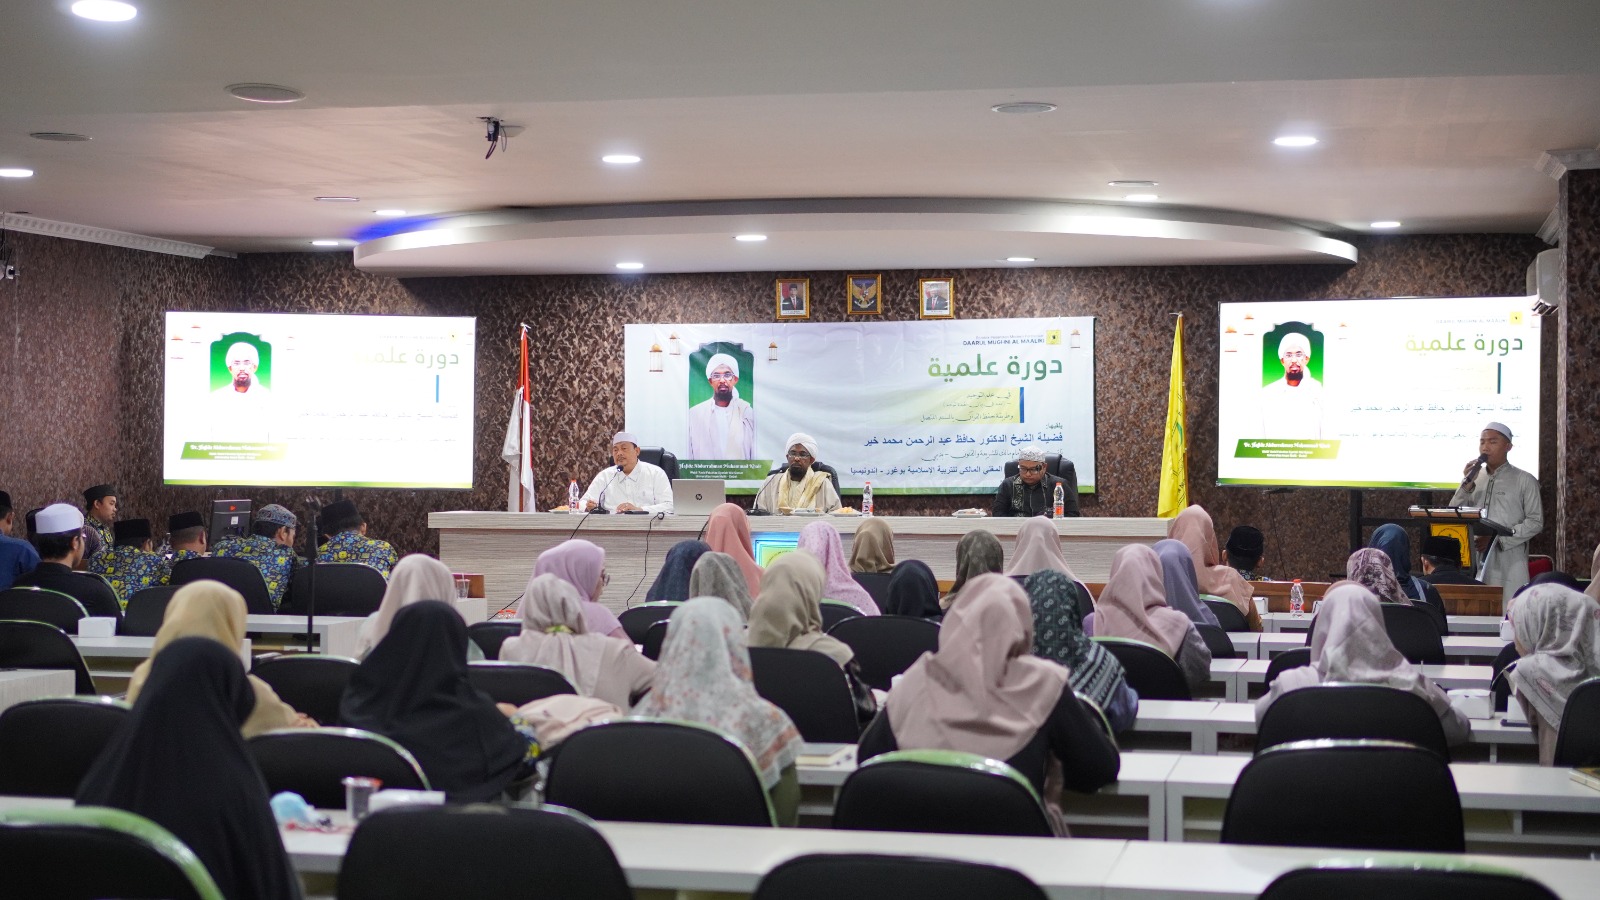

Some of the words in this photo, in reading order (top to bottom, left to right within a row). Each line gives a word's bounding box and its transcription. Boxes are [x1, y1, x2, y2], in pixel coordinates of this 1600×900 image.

[1405, 331, 1466, 357] علمية
[1474, 333, 1523, 356] دورة
[414, 348, 459, 370] دورة
[928, 353, 998, 382] علمية
[1006, 355, 1063, 381] دورة
[864, 436, 879, 447] خير
[906, 436, 934, 446] الرحمن
[938, 436, 952, 446] عبد
[955, 433, 976, 444] حافظ
[979, 434, 1007, 446] الدكتور
[1010, 433, 1034, 446] الشيخ
[1037, 431, 1064, 444] فضيلة
